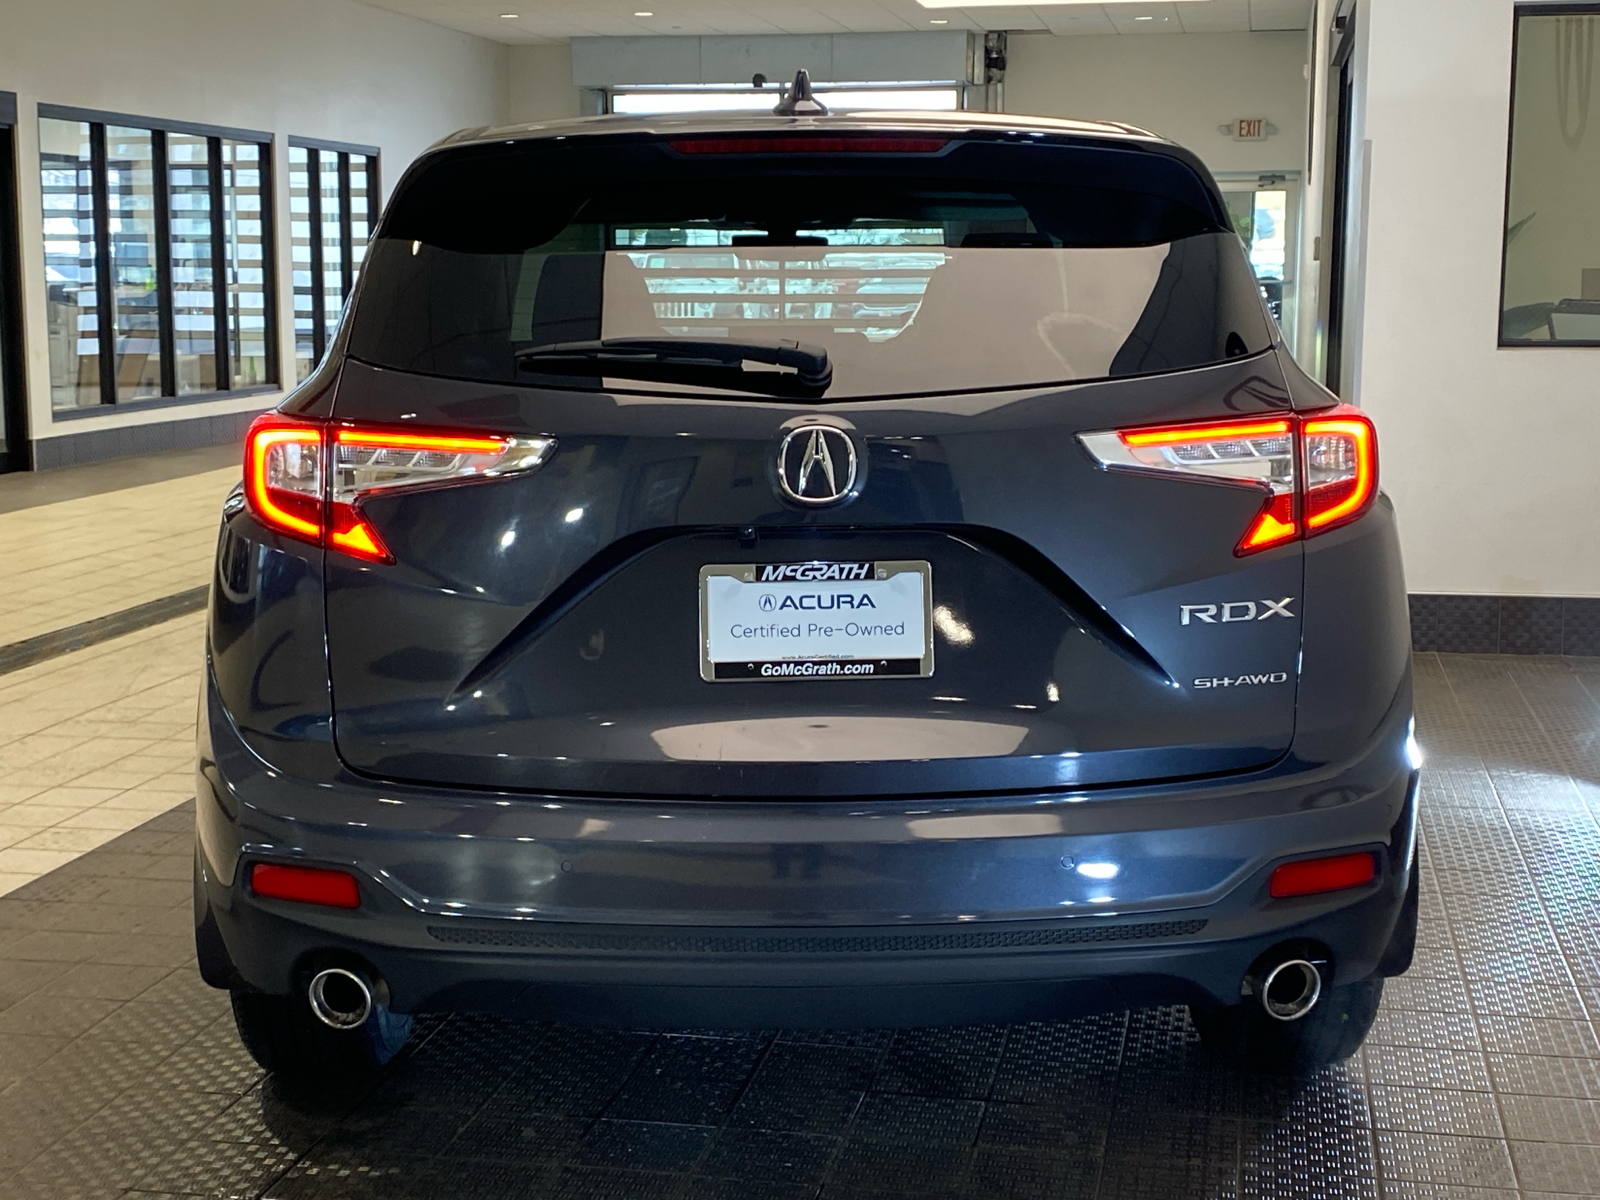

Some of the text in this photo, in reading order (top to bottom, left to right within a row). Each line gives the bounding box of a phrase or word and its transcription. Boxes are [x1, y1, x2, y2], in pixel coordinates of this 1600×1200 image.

[1239, 119, 1262, 138] EXIT
[778, 594, 877, 610] ACURA
[1180, 597, 1295, 626] RDX
[730, 622, 905, 638] Certified Pre-Owned
[761, 662, 874, 677] GoMcGrath.com
